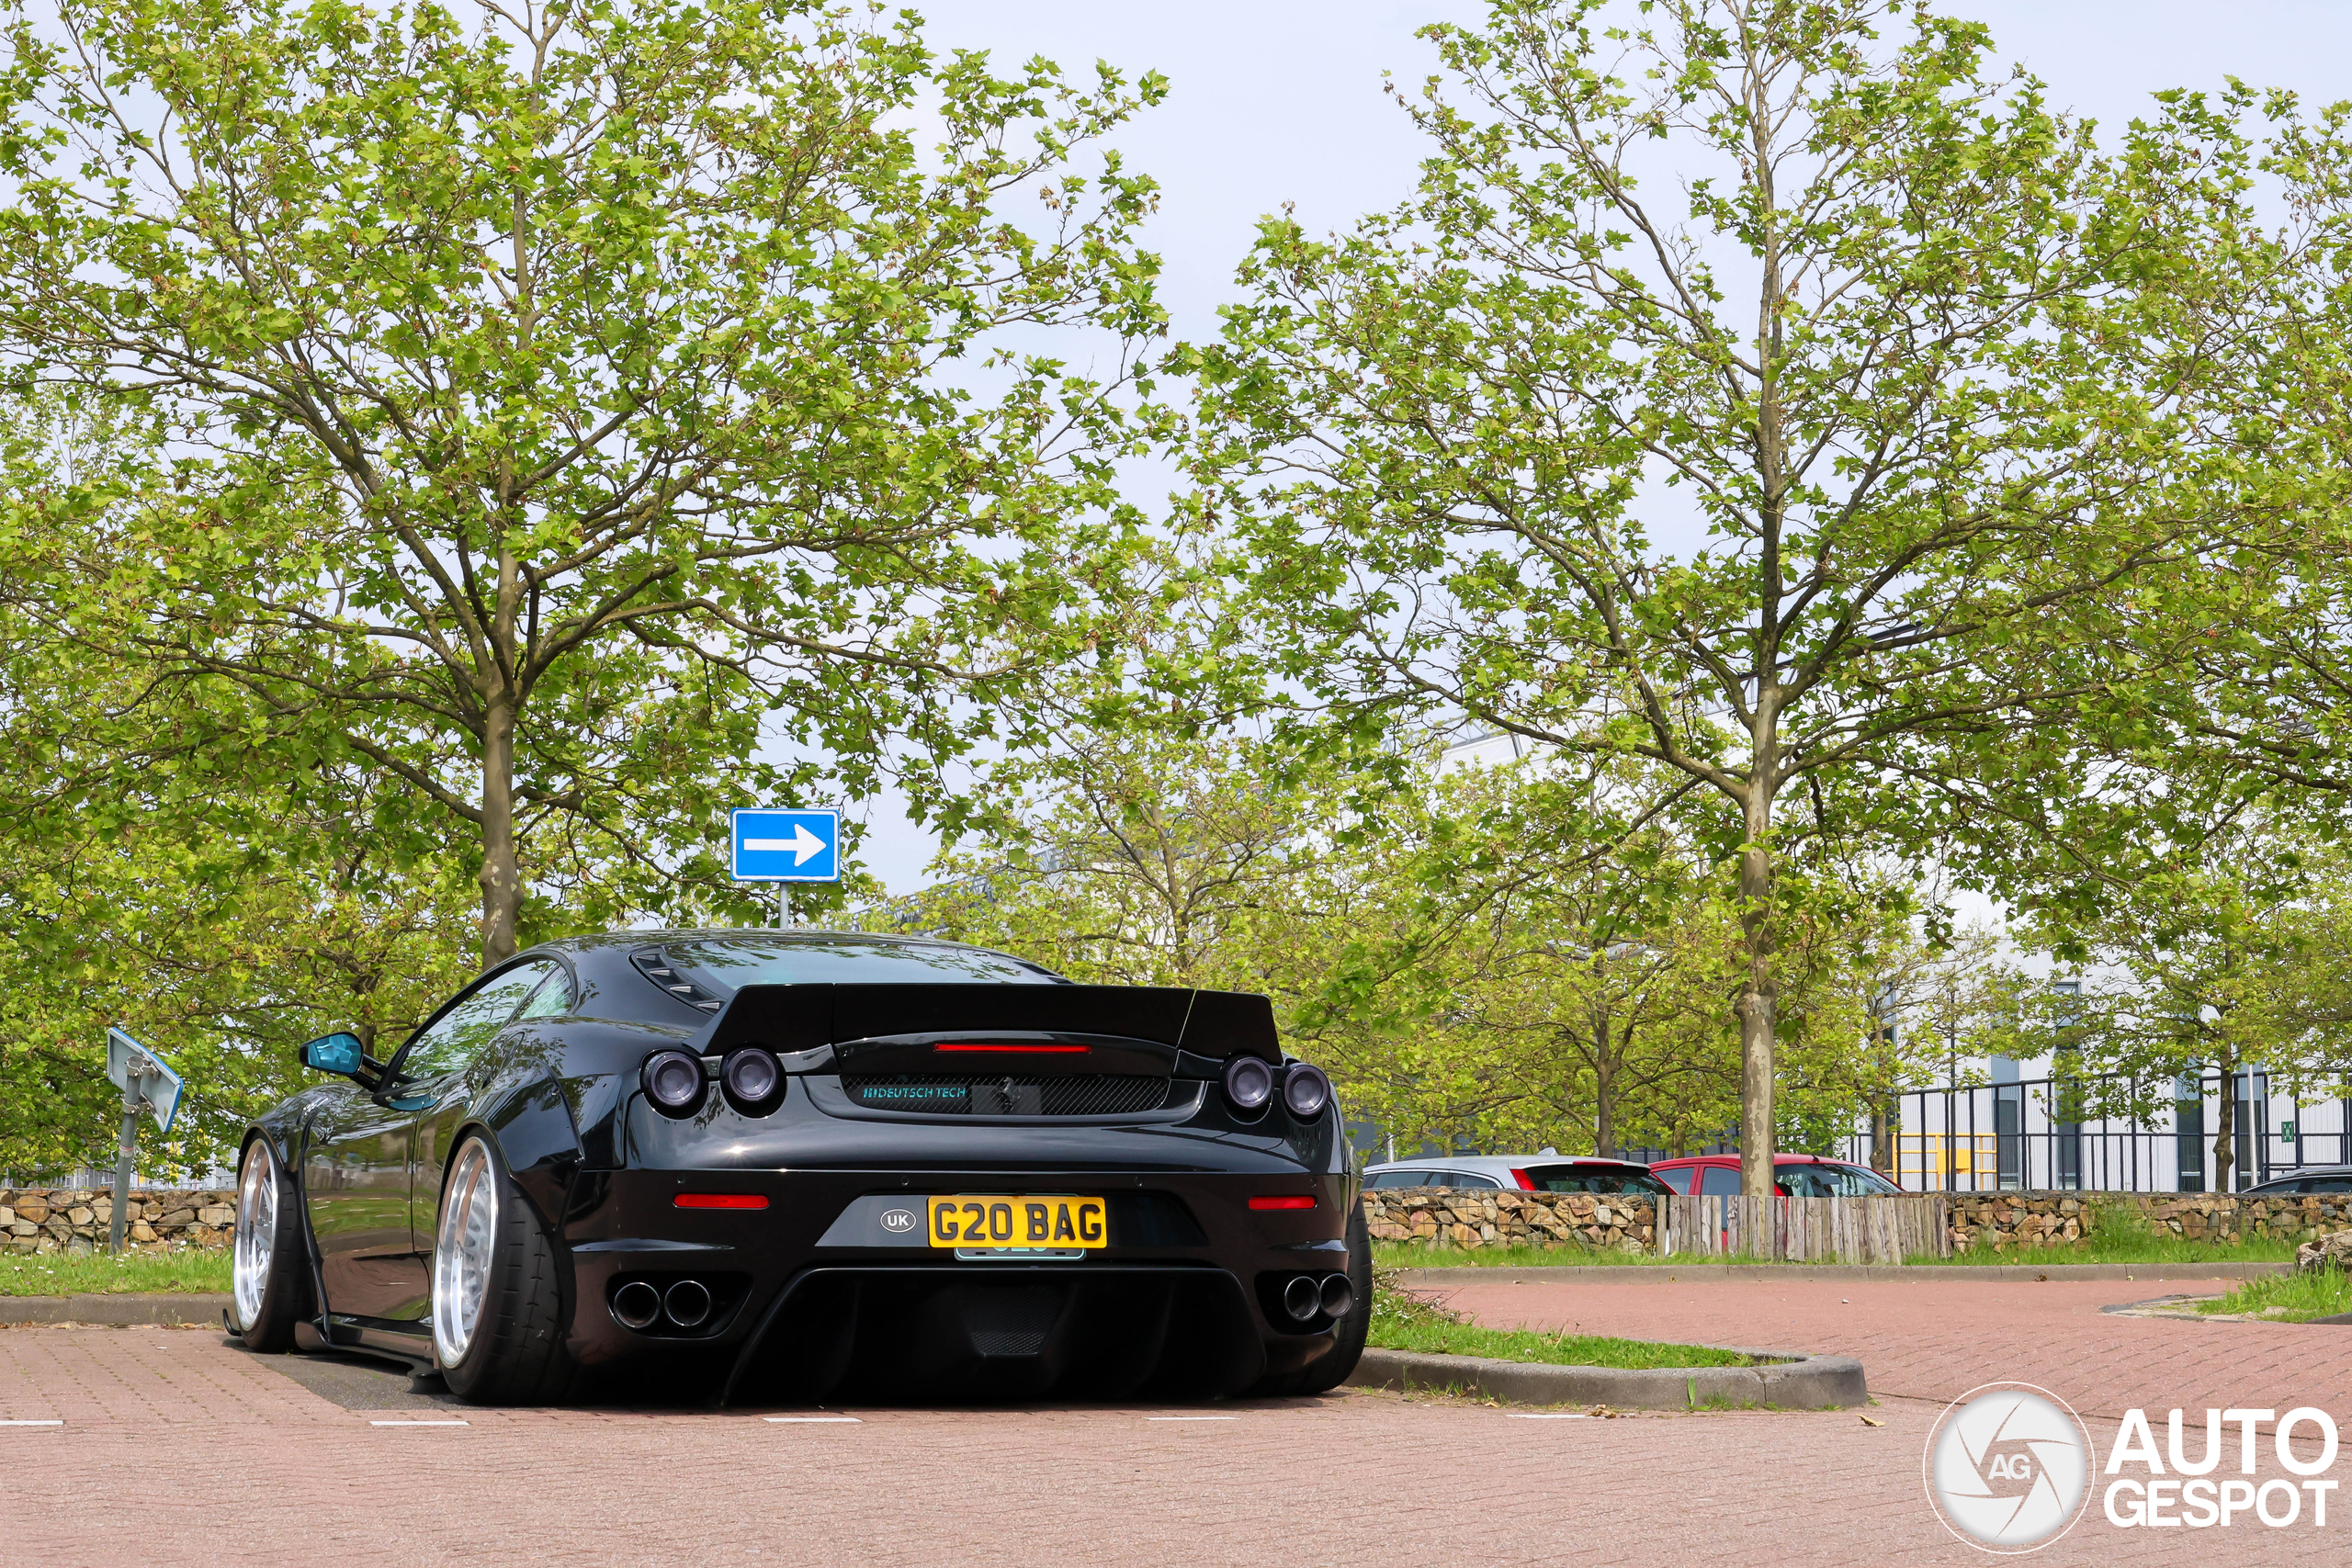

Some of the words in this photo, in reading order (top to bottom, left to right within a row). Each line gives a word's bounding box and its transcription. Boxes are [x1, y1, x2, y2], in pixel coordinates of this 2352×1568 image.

[877, 1088, 933, 1099] DEUTSCH
[935, 1088, 967, 1099] TECH
[887, 1214, 909, 1227] UK
[934, 1202, 1013, 1241] G20
[1024, 1202, 1102, 1242] BAG
